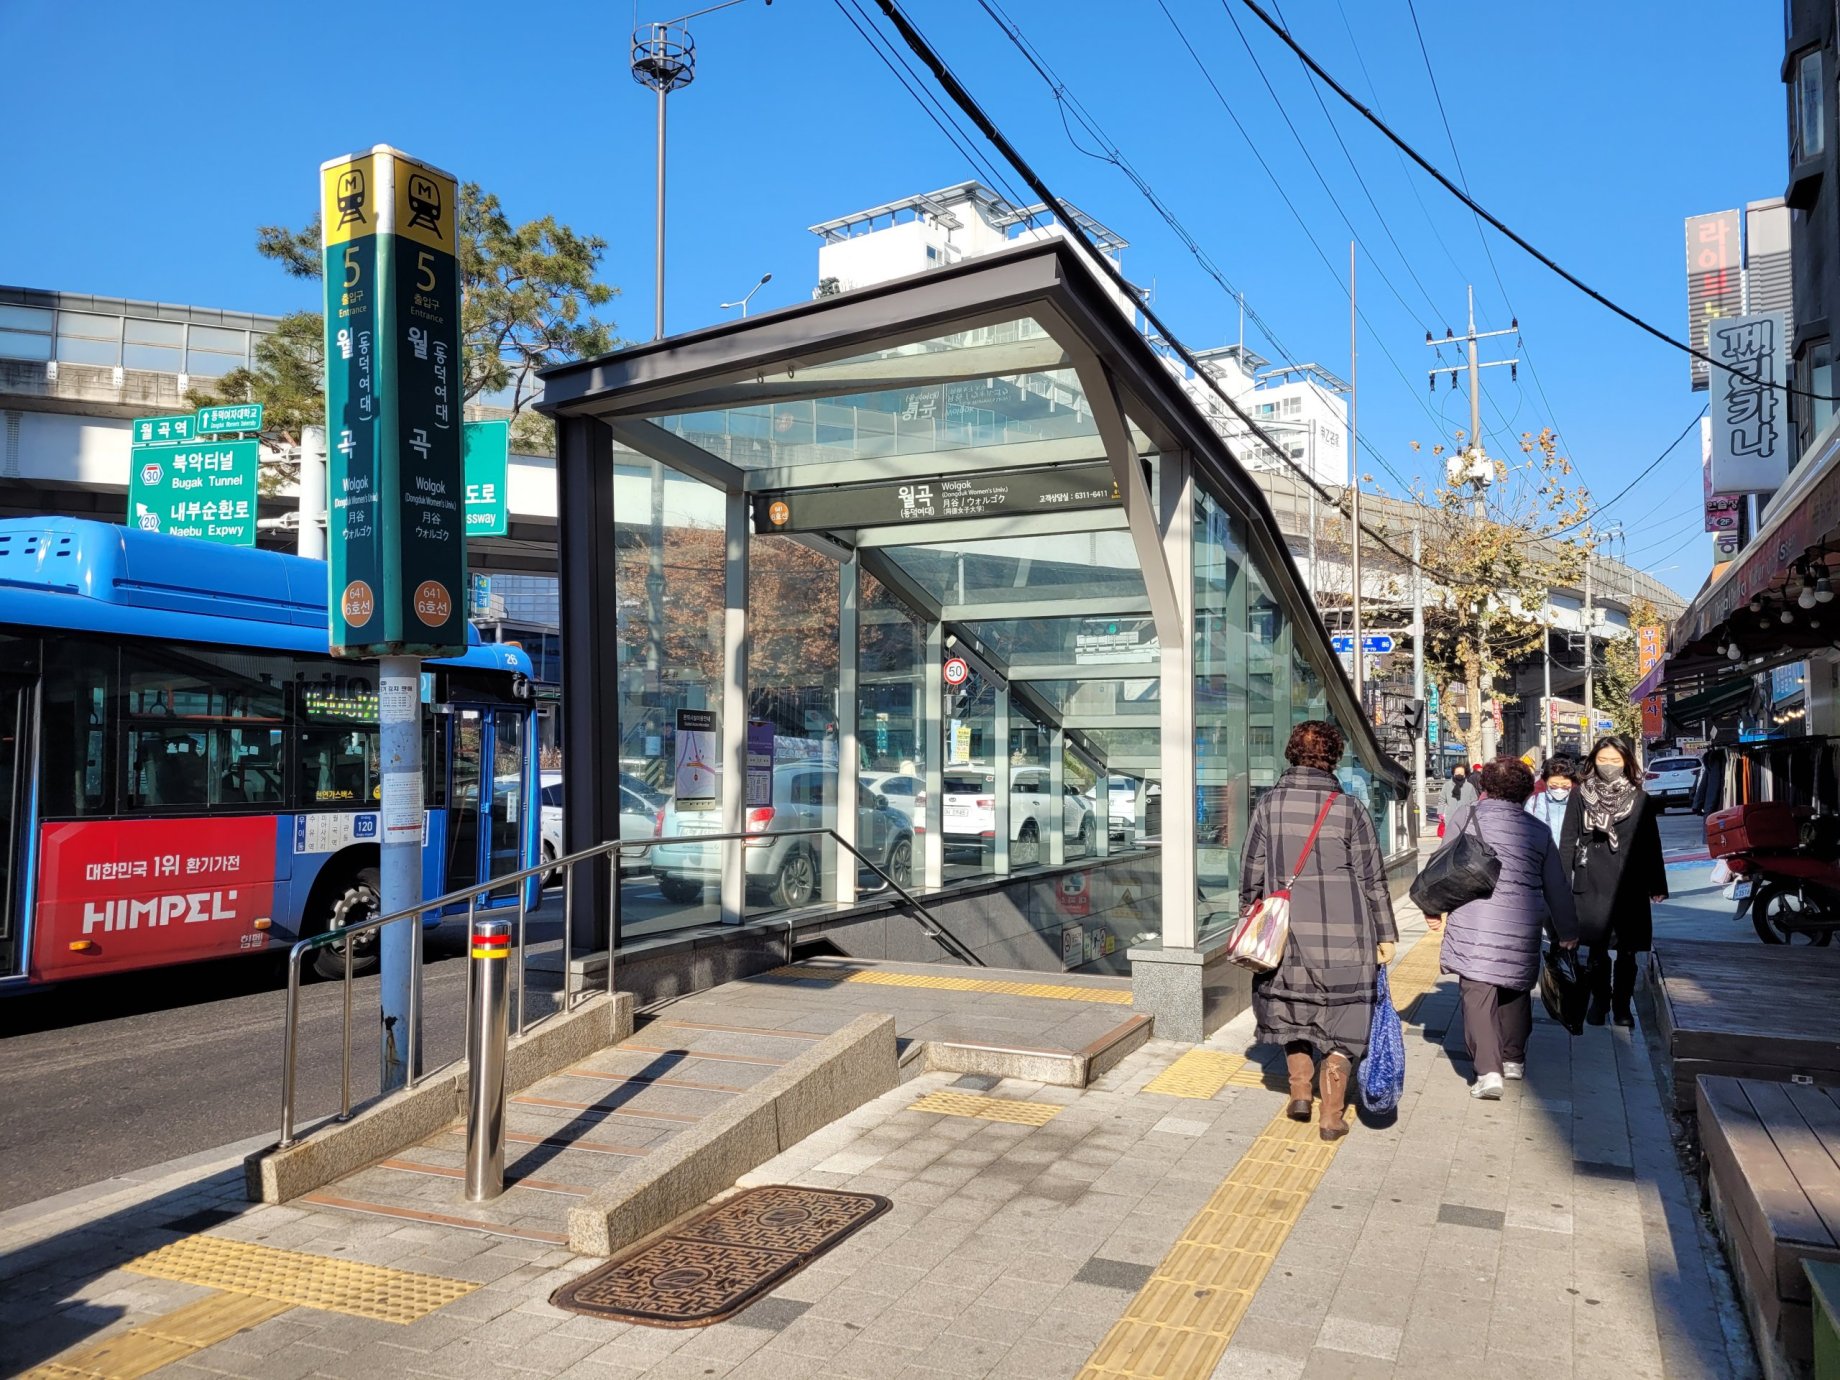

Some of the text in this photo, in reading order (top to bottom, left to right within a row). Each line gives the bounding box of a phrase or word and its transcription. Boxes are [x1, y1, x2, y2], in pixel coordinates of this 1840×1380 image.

[1698, 219, 1732, 297] 라이브
[343, 246, 361, 288] 5
[416, 251, 436, 292] 5
[341, 290, 364, 306] 출입구
[414, 293, 440, 311] 출입구
[338, 305, 367, 318] Entrance
[410, 307, 444, 325] Entrance
[1717, 319, 1779, 458] 페리카나
[172, 451, 234, 473] 북악터널
[145, 470, 159, 481] 30
[171, 474, 243, 490] Bugak Tunnel
[342, 474, 369, 493] Wolgok
[415, 476, 446, 495] Wolgok
[941, 480, 971, 492] Wolgok
[898, 485, 934, 509] 월곡
[943, 498, 959, 508] 月谷
[967, 494, 1005, 506] ウォルゴク
[1074, 490, 1108, 500] 6311-6411
[170, 500, 250, 521] 내부순환로
[348, 510, 365, 524] 月谷
[422, 511, 441, 525] 月谷
[900, 506, 935, 519] (동덕여대)
[143, 516, 156, 528] 20
[169, 524, 244, 538] Naebu Expwy
[342, 525, 372, 540] ウォルゴク
[415, 525, 450, 542] ウォルゴク
[349, 587, 364, 599] 641
[423, 587, 441, 599] 641
[345, 601, 371, 616] 6호선
[418, 601, 447, 616] 6호선
[505, 652, 518, 666] 26
[948, 665, 963, 677] 50
[357, 821, 373, 832] 120
[85, 854, 240, 881] 대한민국 1위 환기가전
